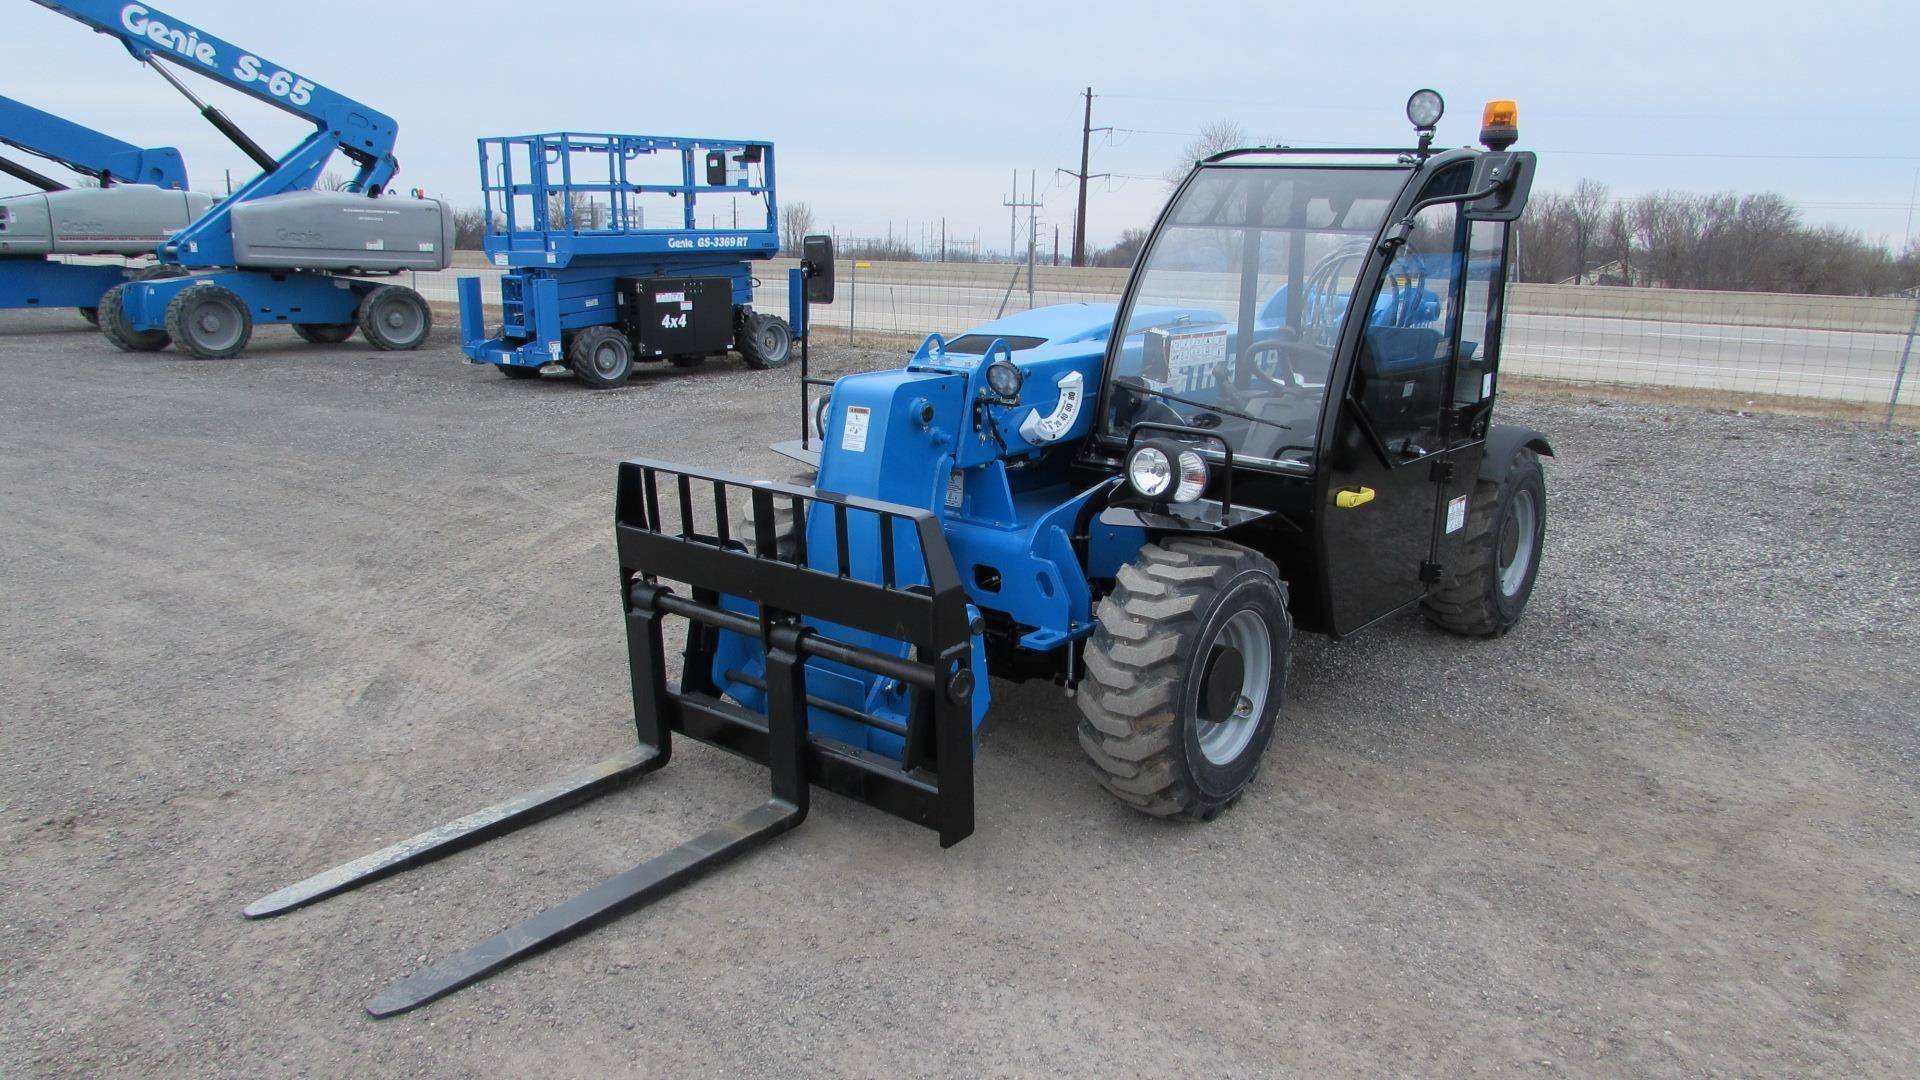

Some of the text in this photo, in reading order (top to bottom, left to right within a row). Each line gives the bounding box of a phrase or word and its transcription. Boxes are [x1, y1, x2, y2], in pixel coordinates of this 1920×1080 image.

[121, 4, 316, 106] Genie S-65
[668, 238, 694, 249] Genie
[697, 236, 736, 248] GS-3369
[736, 236, 749, 247] RT
[661, 313, 687, 329] 4x4
[1067, 391, 1076, 401] 80
[1064, 403, 1073, 412] 60
[1060, 413, 1069, 421] 40
